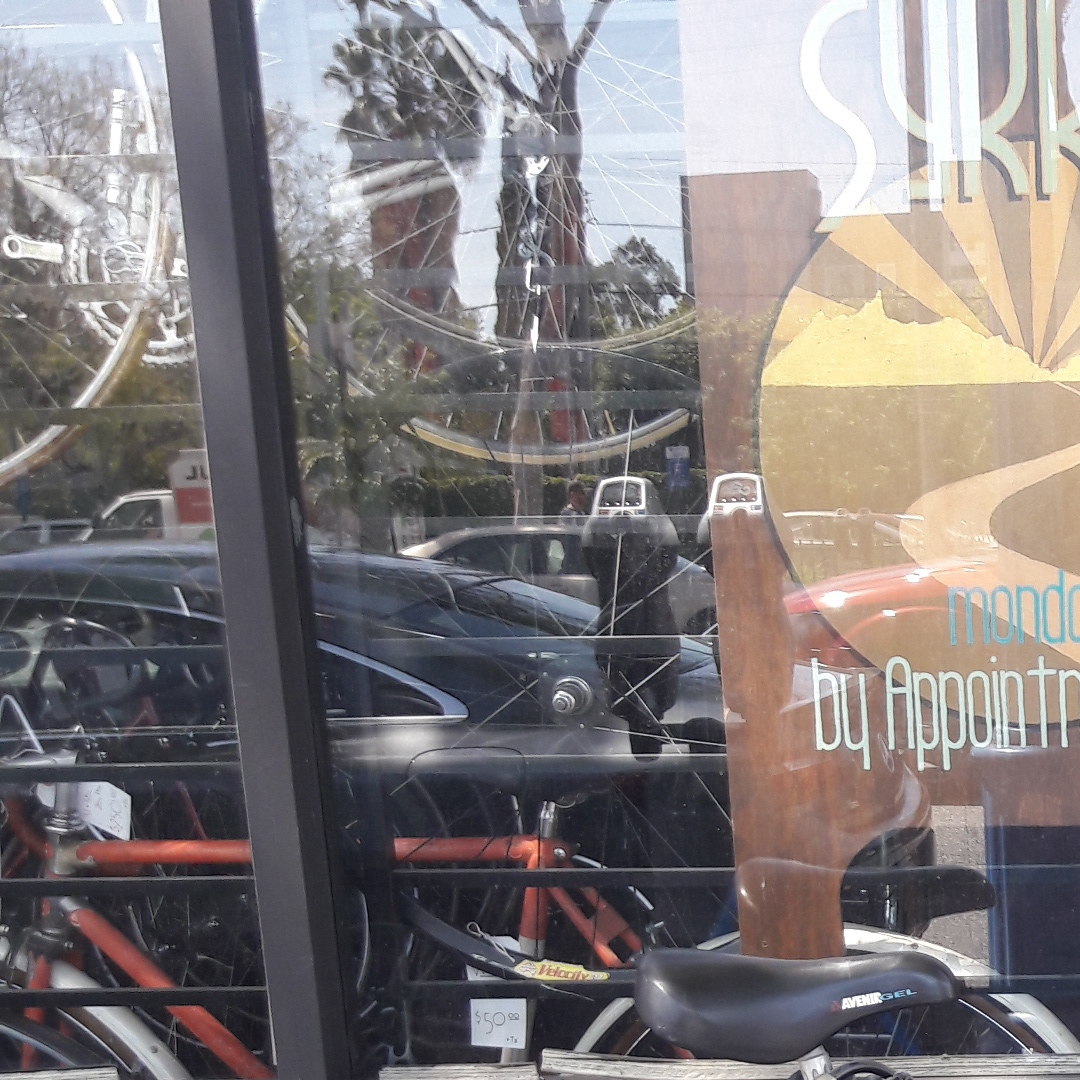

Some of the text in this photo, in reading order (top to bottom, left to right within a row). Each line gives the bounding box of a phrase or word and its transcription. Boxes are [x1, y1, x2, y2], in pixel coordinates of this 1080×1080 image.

[810, 650, 871, 770] by
[537, 964, 589, 981] Velocity
[842, 989, 918, 1010] AVENIR GEL
